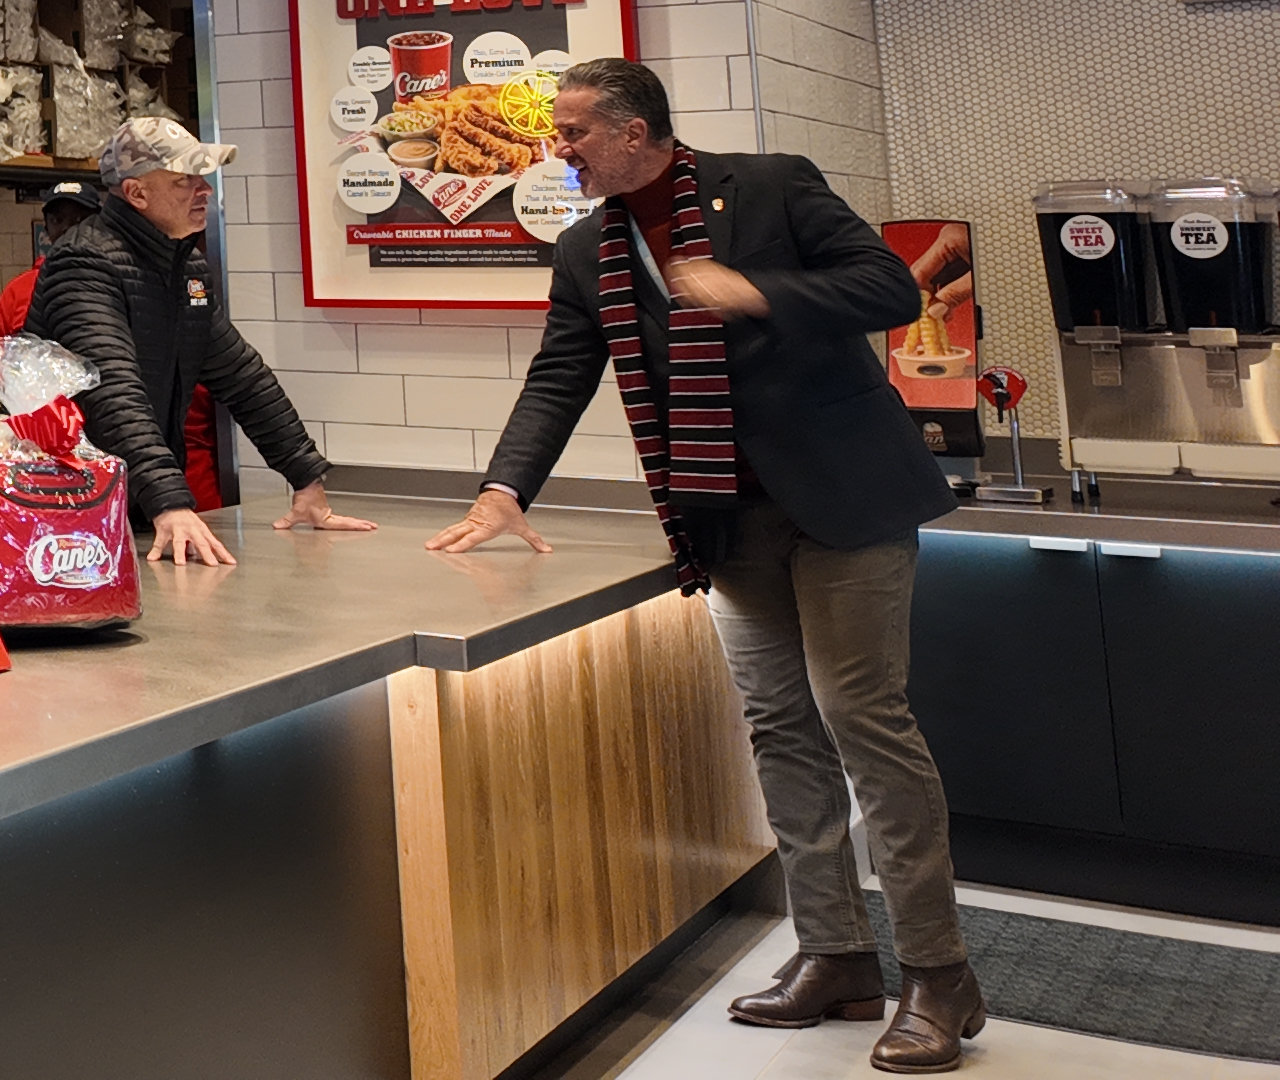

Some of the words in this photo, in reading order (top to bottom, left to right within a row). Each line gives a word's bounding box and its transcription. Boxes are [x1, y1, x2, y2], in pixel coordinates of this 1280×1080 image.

[470, 58, 524, 69] Premium
[395, 69, 448, 97] Cane's
[341, 107, 367, 115] Fresh
[342, 178, 395, 188] Handmade
[449, 201, 471, 222] ONE
[468, 178, 494, 204] LOVE
[395, 229, 441, 239] CHICKEN
[443, 229, 483, 239] FINGER
[1069, 226, 1104, 235] SWEET
[1070, 235, 1106, 247] TEA
[1181, 232, 1218, 245] TEA
[33, 537, 110, 583] Cane's
